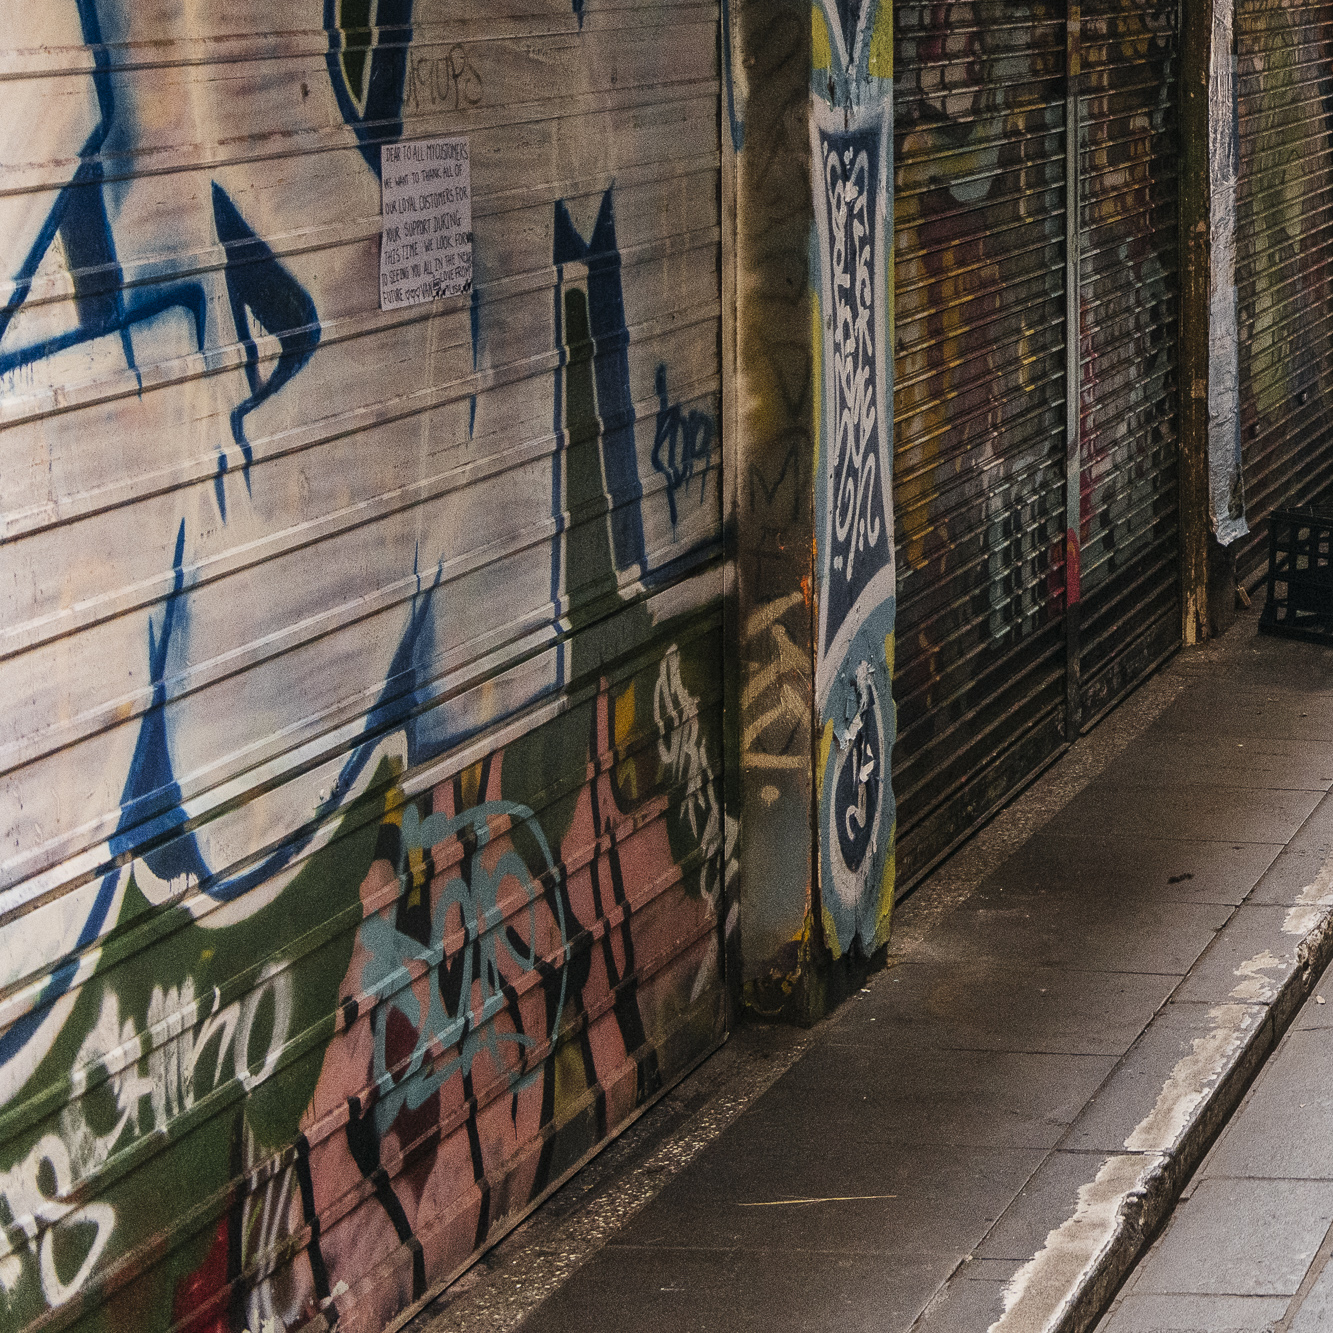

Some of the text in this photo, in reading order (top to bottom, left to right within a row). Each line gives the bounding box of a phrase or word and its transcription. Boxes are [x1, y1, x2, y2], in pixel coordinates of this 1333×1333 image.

[385, 146, 400, 162] DEAR
[403, 146, 411, 160] TO
[413, 146, 425, 161] ALL
[384, 164, 462, 189] WE WANT TO THANK ALL OF
[385, 186, 469, 215] OUR LOYAL CUSTOMERS FOR
[385, 210, 461, 245] YOUR SUPPORT DURING
[384, 249, 400, 265] THIS
[401, 242, 418, 260] TIME
[424, 238, 433, 252] WE
[436, 235, 454, 250] LOOK
[381, 273, 388, 286] TO
[389, 267, 409, 284] SEEING
[411, 264, 421, 278] YOU
[424, 260, 433, 275] ALL
[444, 253, 455, 266] THE
[383, 287, 404, 304] FUTURE
[455, 264, 472, 278] FROM
